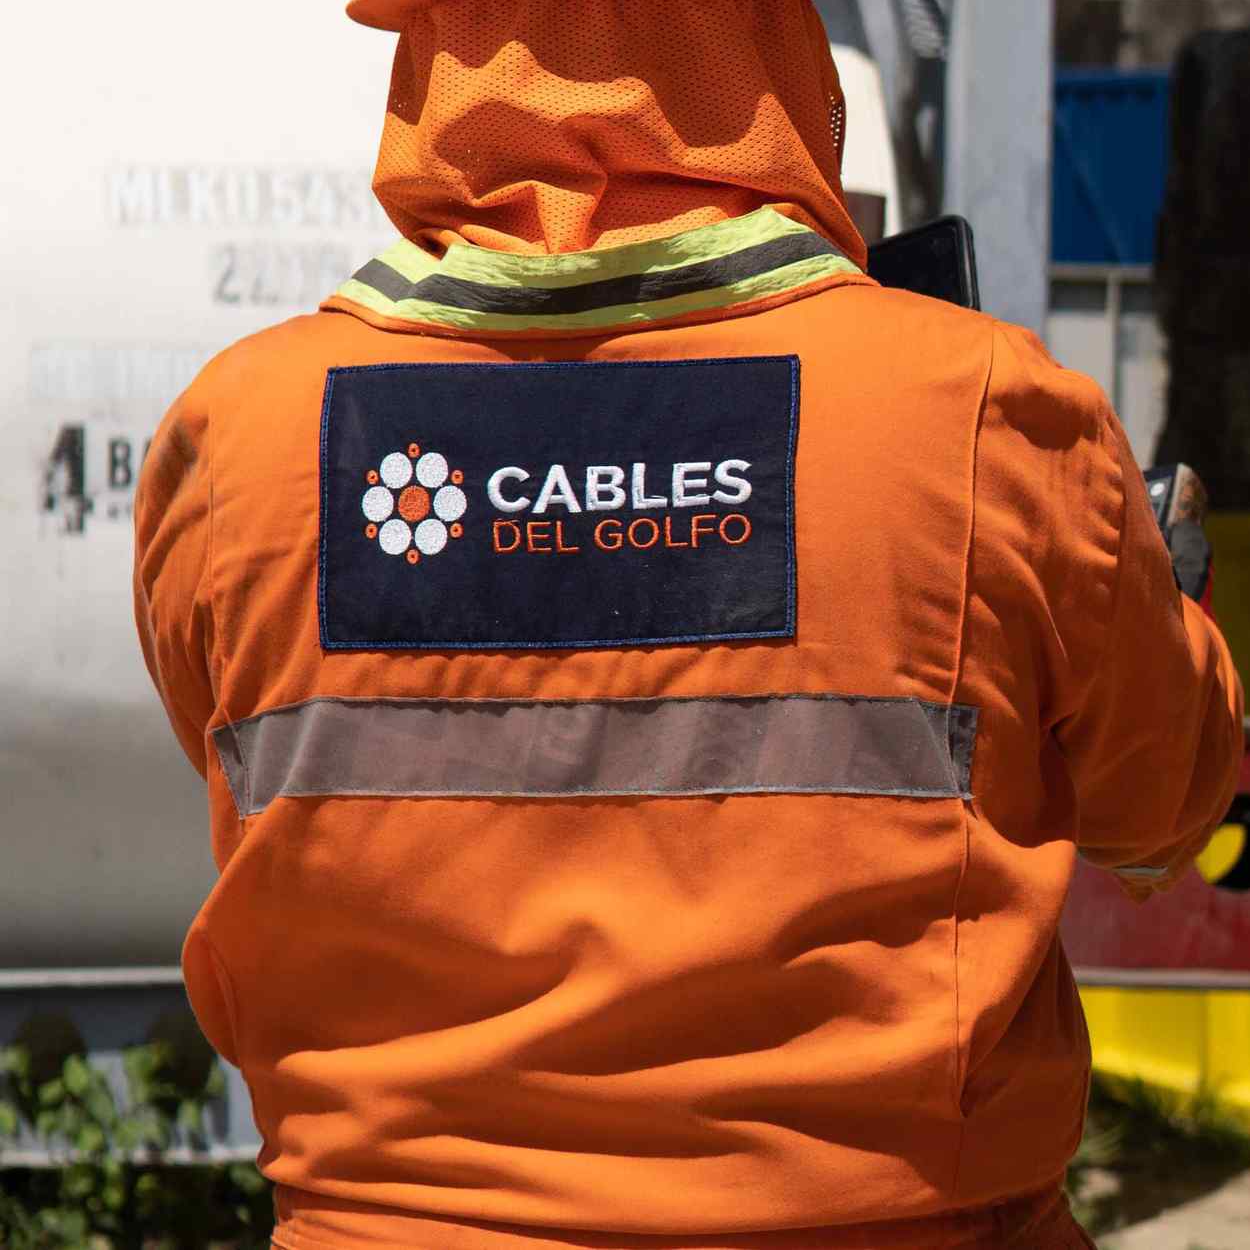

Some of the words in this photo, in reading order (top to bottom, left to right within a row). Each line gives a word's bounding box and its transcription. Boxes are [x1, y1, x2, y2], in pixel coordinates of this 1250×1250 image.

[487, 459, 752, 514] CABLES
[493, 518, 579, 554] DEL
[594, 513, 752, 550] GOLFO
